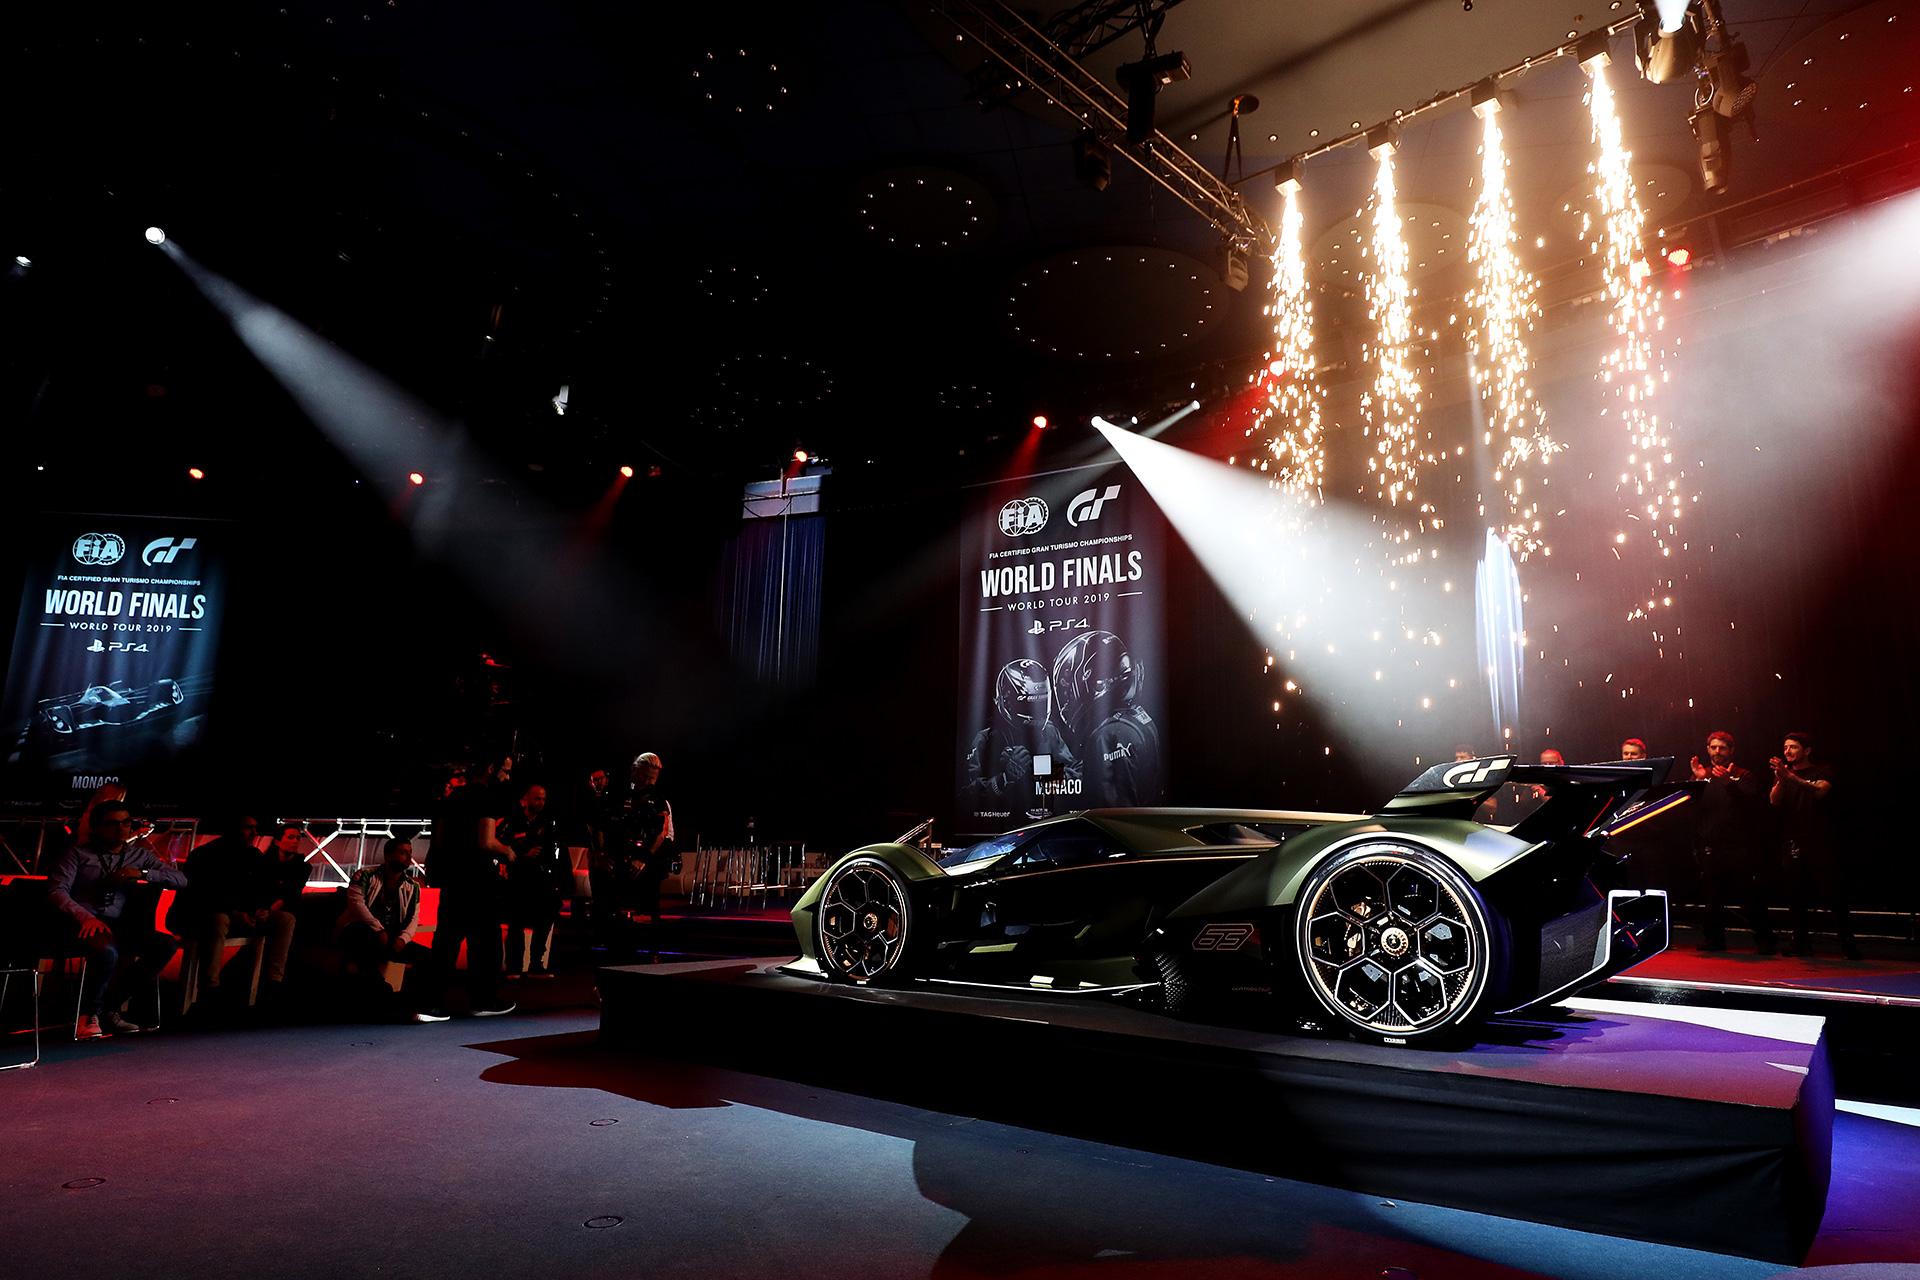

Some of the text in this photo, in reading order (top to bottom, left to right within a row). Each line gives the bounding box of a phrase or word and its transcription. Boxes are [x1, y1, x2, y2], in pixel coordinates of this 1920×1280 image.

[999, 548, 1031, 558] CERTIFIED
[1031, 545, 1050, 554] GRAN
[1050, 541, 1079, 551] TURISMO
[1079, 534, 1133, 547] CHAMPIONSHIPS
[150, 578, 201, 586] CHAMPIONSHIPS
[981, 550, 1143, 598] WORLD FINALS
[45, 589, 207, 619] WORLD FINALS
[1007, 592, 1110, 612] WORLD TOUR 2019
[69, 622, 172, 633] WORLD TOUR 2019
[1049, 618, 1090, 632] PS4
[108, 641, 150, 652] PS4
[1103, 748, 1127, 761] PUMA
[1192, 923, 1254, 950] 63
